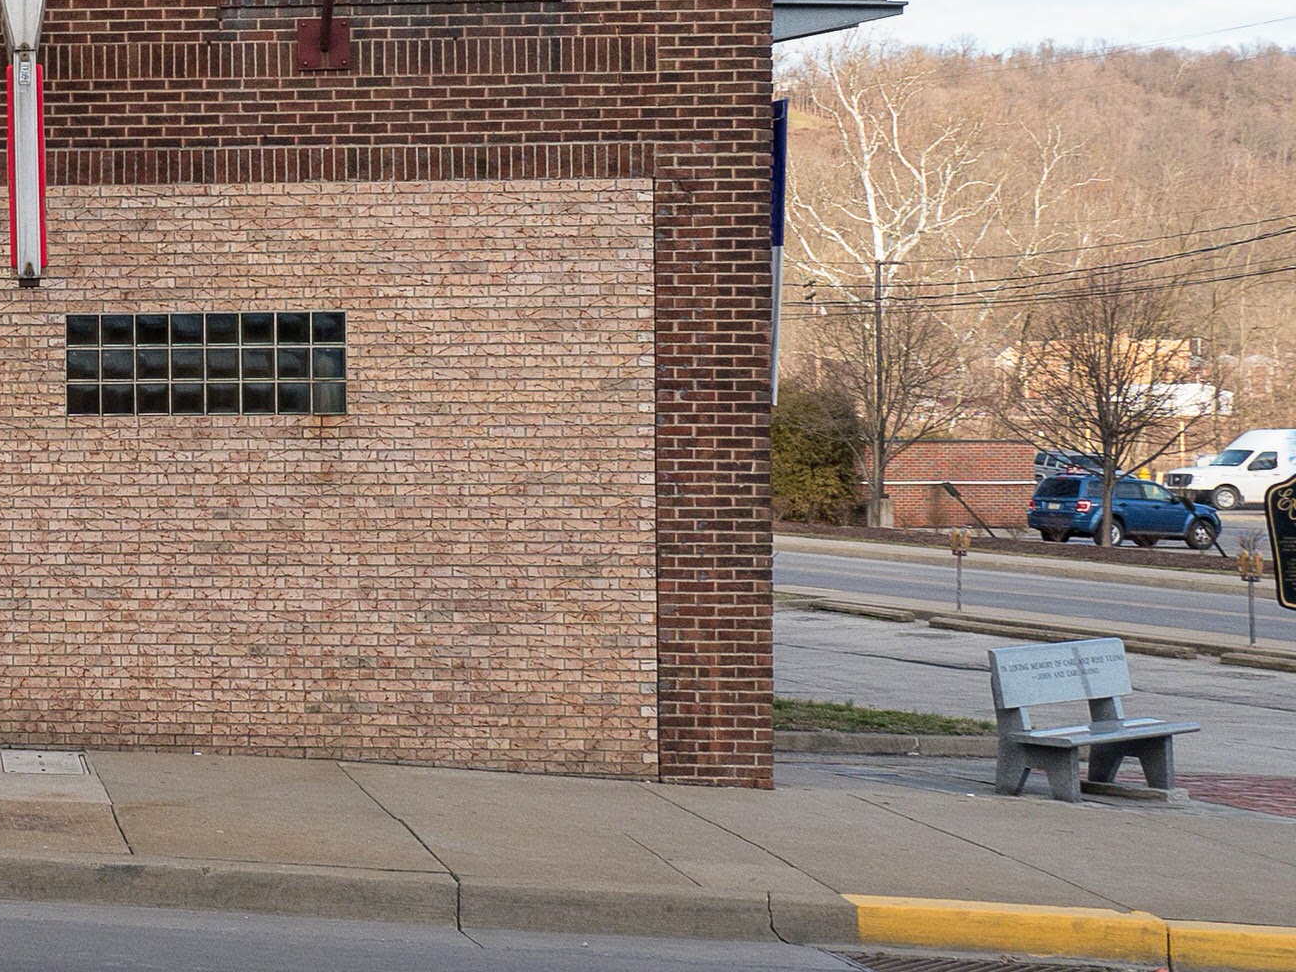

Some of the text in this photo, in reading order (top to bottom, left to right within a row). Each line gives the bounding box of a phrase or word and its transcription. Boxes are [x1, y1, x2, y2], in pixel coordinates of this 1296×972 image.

[1008, 663, 1029, 672] LOVING
[1030, 661, 1053, 670] MEMORY
[1054, 659, 1063, 668] OF
